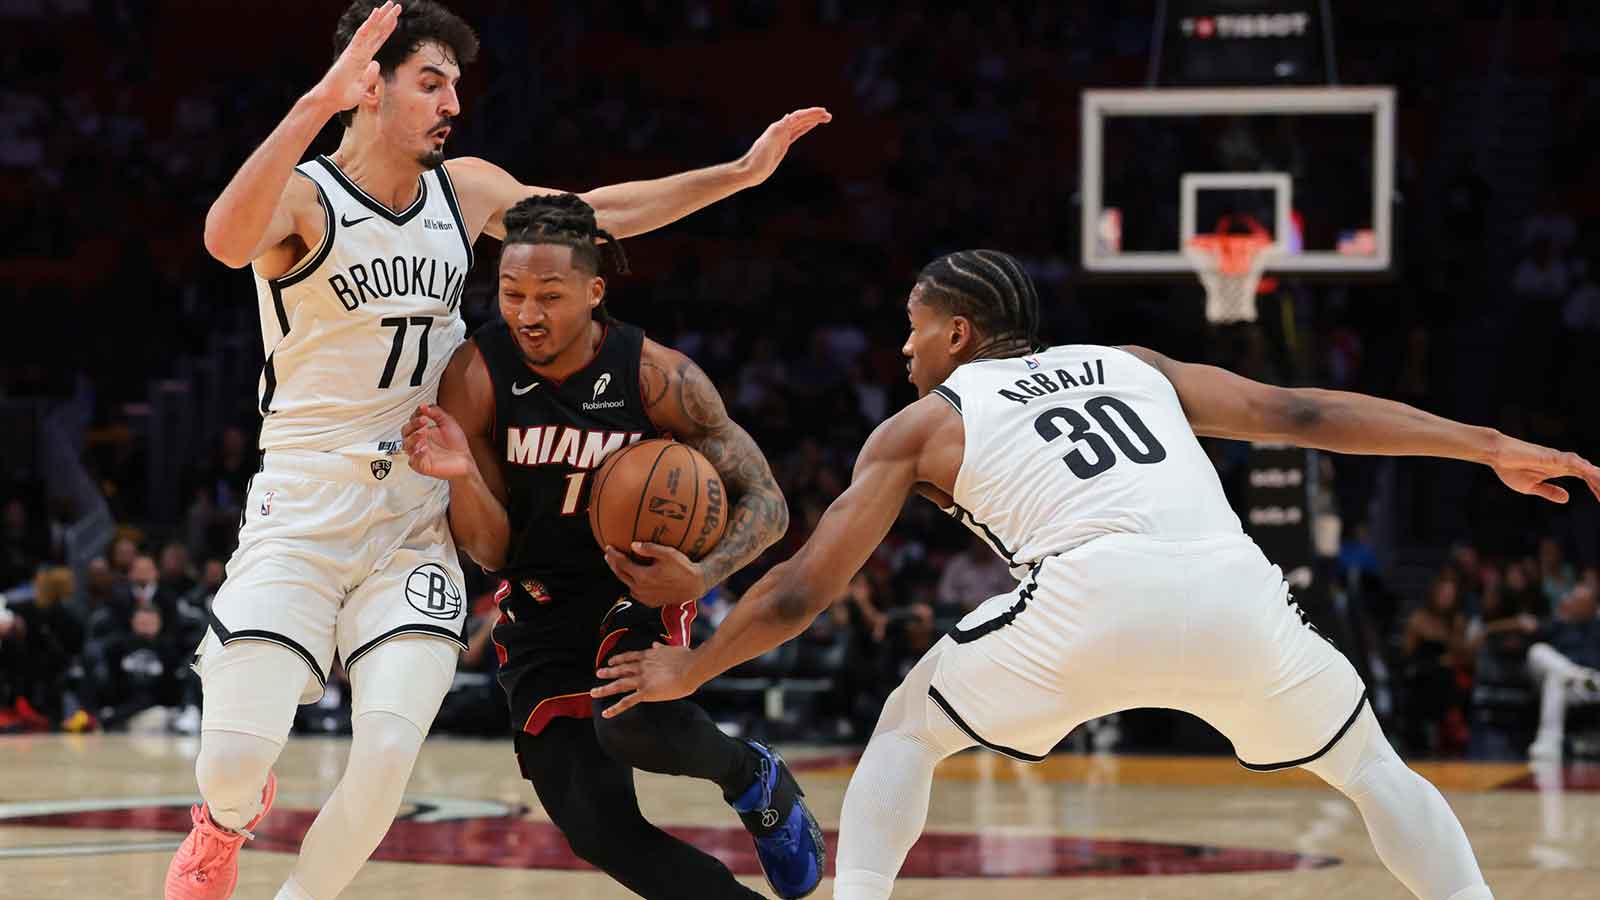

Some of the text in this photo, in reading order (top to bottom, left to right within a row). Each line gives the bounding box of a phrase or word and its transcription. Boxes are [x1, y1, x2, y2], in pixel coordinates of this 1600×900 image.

[328, 256, 464, 313] BROOKLYN
[377, 317, 433, 389] 77
[998, 359, 1105, 404] AGBAJI
[582, 399, 625, 411] Robinhood
[507, 426, 642, 469] MIAM
[1034, 395, 1167, 480] 30
[372, 461, 391, 471] NETS
[427, 573, 446, 611] B
